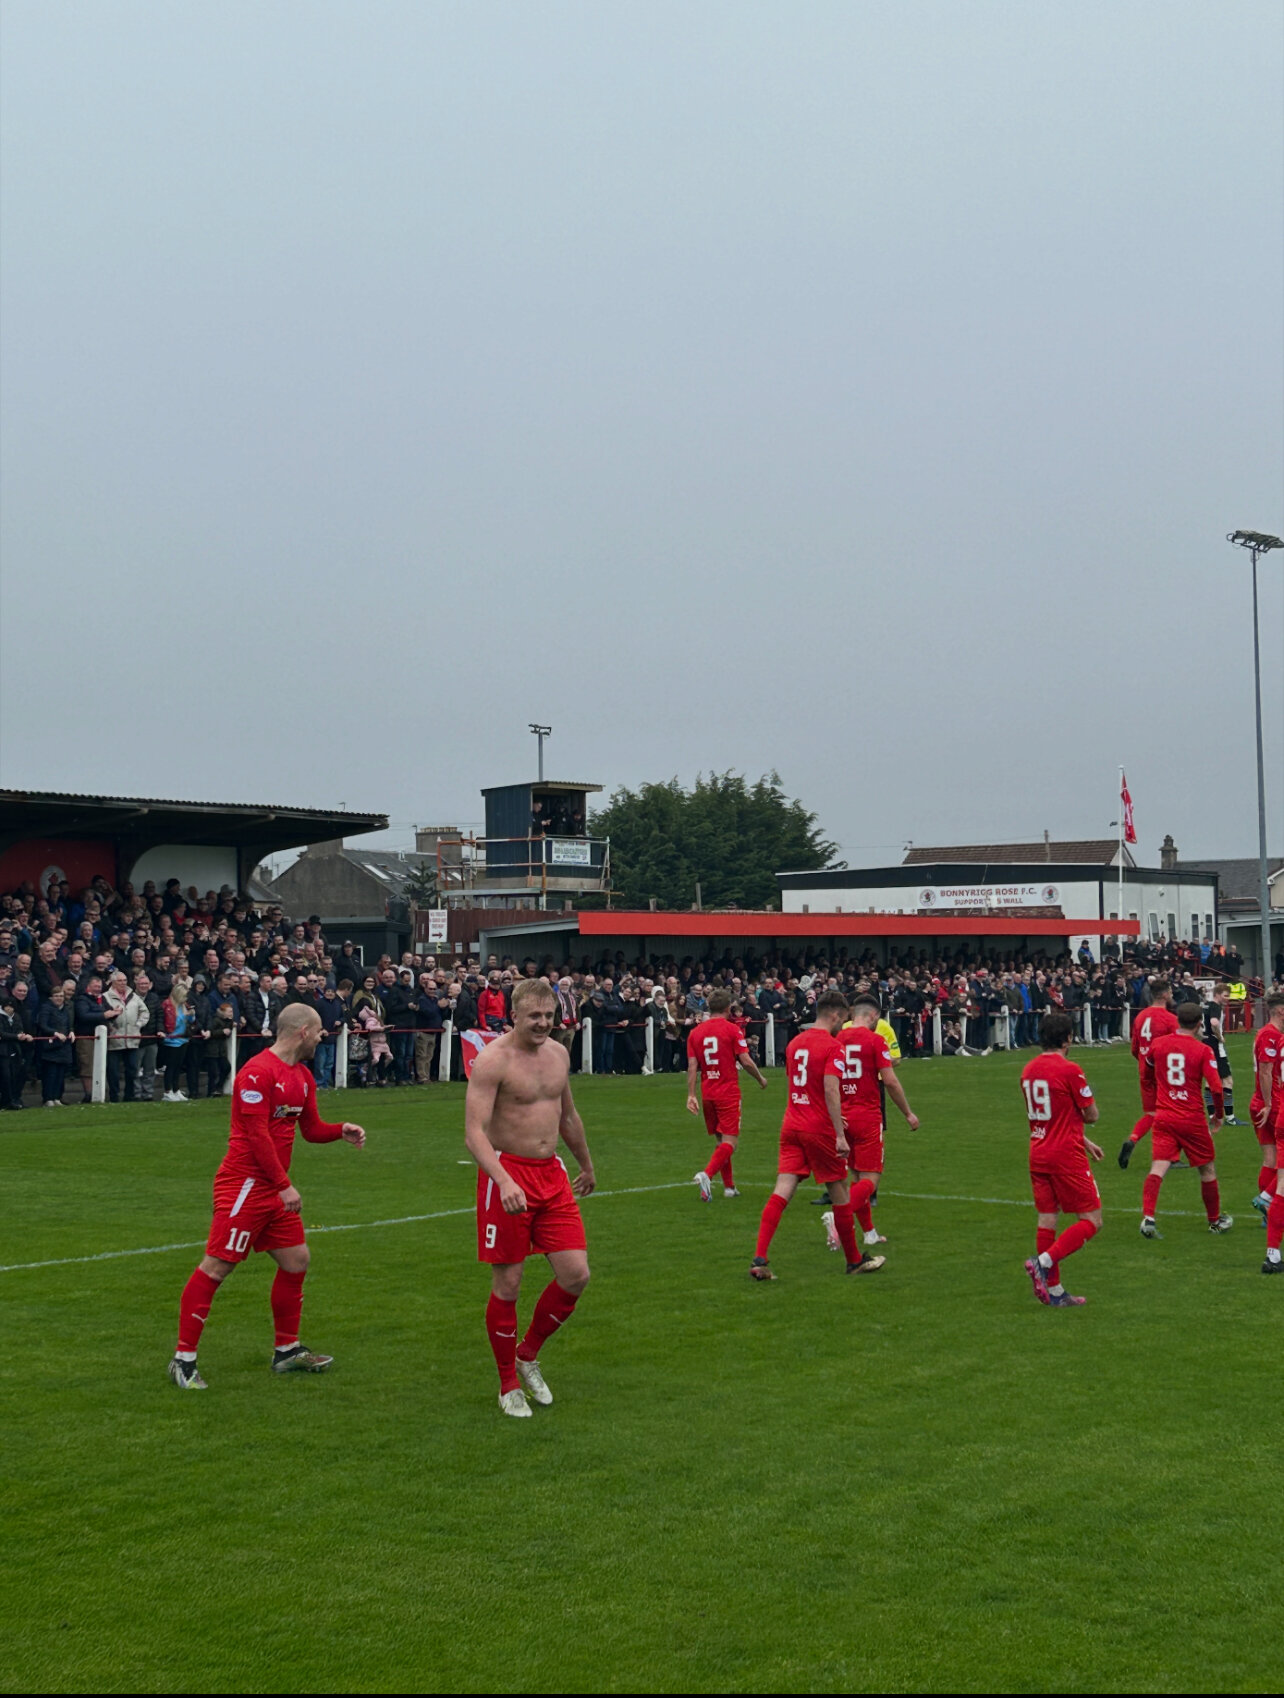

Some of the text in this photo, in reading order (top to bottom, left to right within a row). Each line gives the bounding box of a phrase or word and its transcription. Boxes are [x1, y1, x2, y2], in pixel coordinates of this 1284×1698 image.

[940, 888, 993, 897] BONNYRIGG
[995, 888, 1018, 896] ROSE
[1140, 1017, 1153, 1042] 4
[703, 1036, 719, 1065] 2
[793, 1049, 809, 1087] 3
[1167, 1053, 1186, 1087] 8
[1022, 1079, 1052, 1121] 19
[225, 1227, 251, 1253] 10
[485, 1223, 497, 1249] 9
